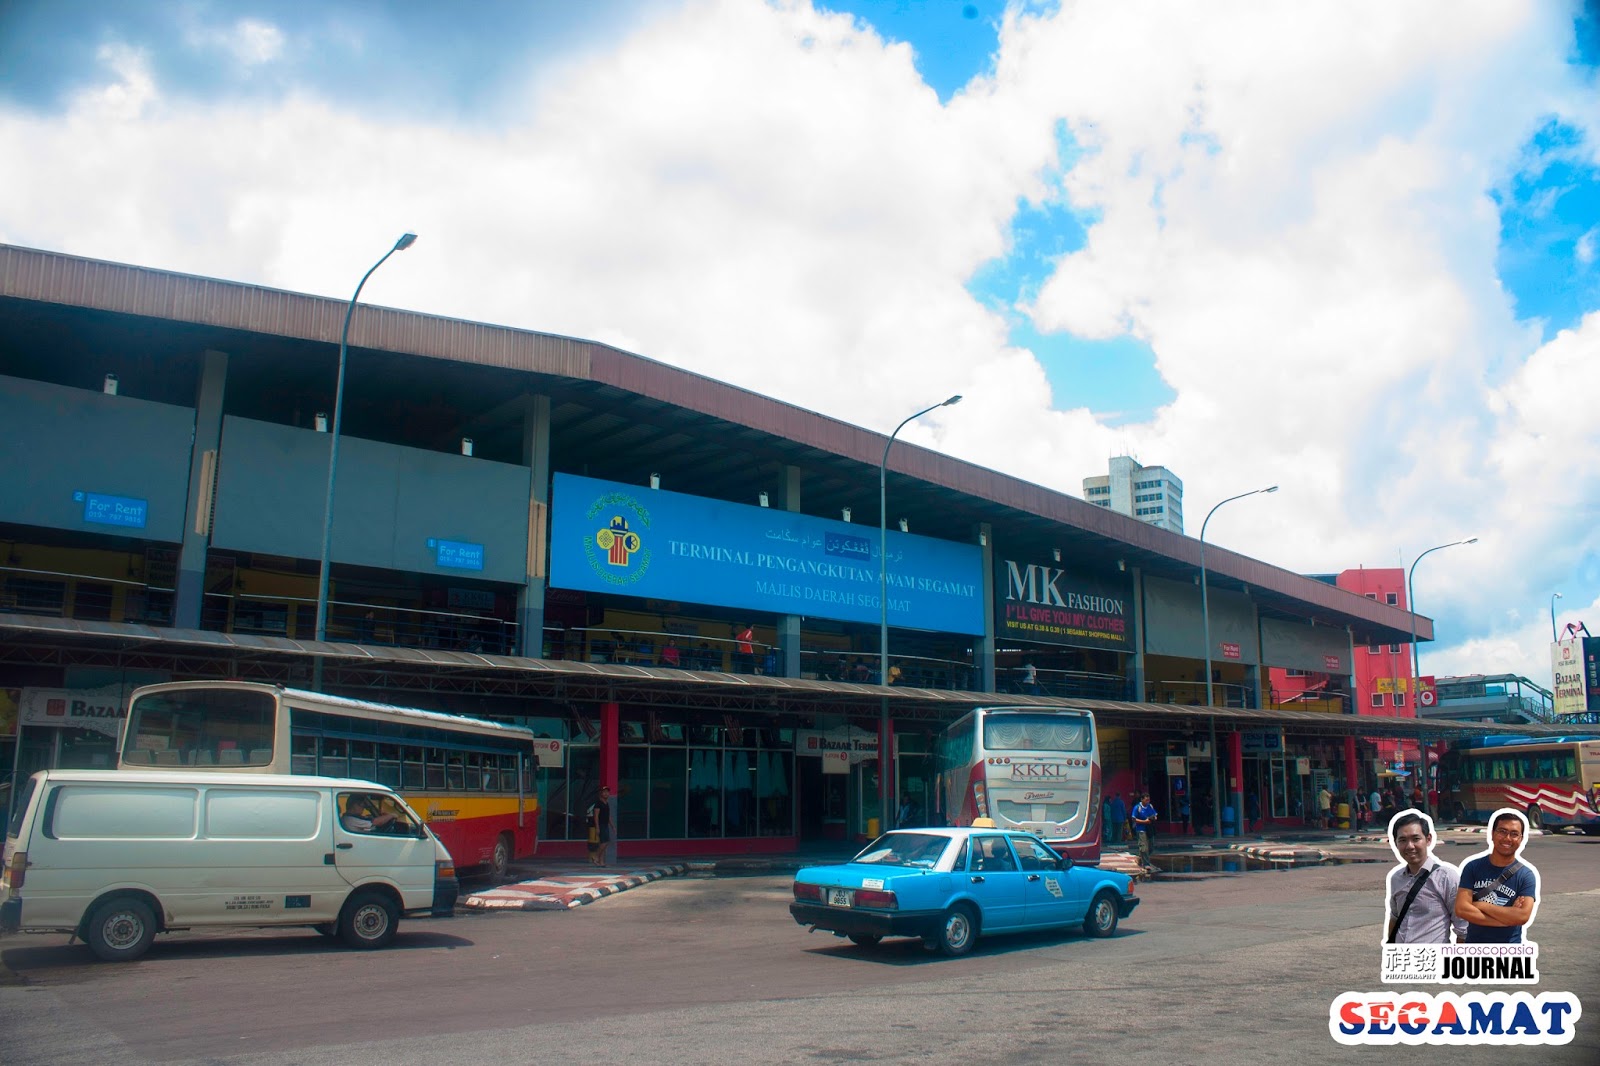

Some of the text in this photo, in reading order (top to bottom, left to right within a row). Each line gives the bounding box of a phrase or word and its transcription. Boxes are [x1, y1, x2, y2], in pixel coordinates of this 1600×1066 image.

[75, 491, 83, 501] 2
[89, 499, 143, 515] For Rent
[440, 545, 480, 559] For Rent
[668, 540, 754, 566] TERMINAL
[757, 552, 874, 582] PENGANGKUTAN
[918, 577, 976, 597] SEGAMAT
[756, 581, 801, 598] MAJLIS
[804, 587, 855, 605] DAERAH
[1004, 560, 1123, 615] MK FASHION
[1030, 607, 1051, 623] GIVE
[1052, 611, 1072, 626] YOU
[1073, 614, 1086, 627] MY
[1087, 615, 1125, 633] CLOTHES
[1006, 620, 1019, 629] VISIT
[1019, 622, 1027, 630] US
[1027, 623, 1034, 631] AT
[1066, 628, 1088, 637] SEGAMAT
[1555, 672, 1580, 685] BAZAAR
[1555, 682, 1584, 699] TERMINAL
[71, 700, 128, 718] BAZAA
[551, 741, 558, 751] 2
[819, 737, 852, 751] BAZAAR
[1012, 764, 1067, 776] KKKL
